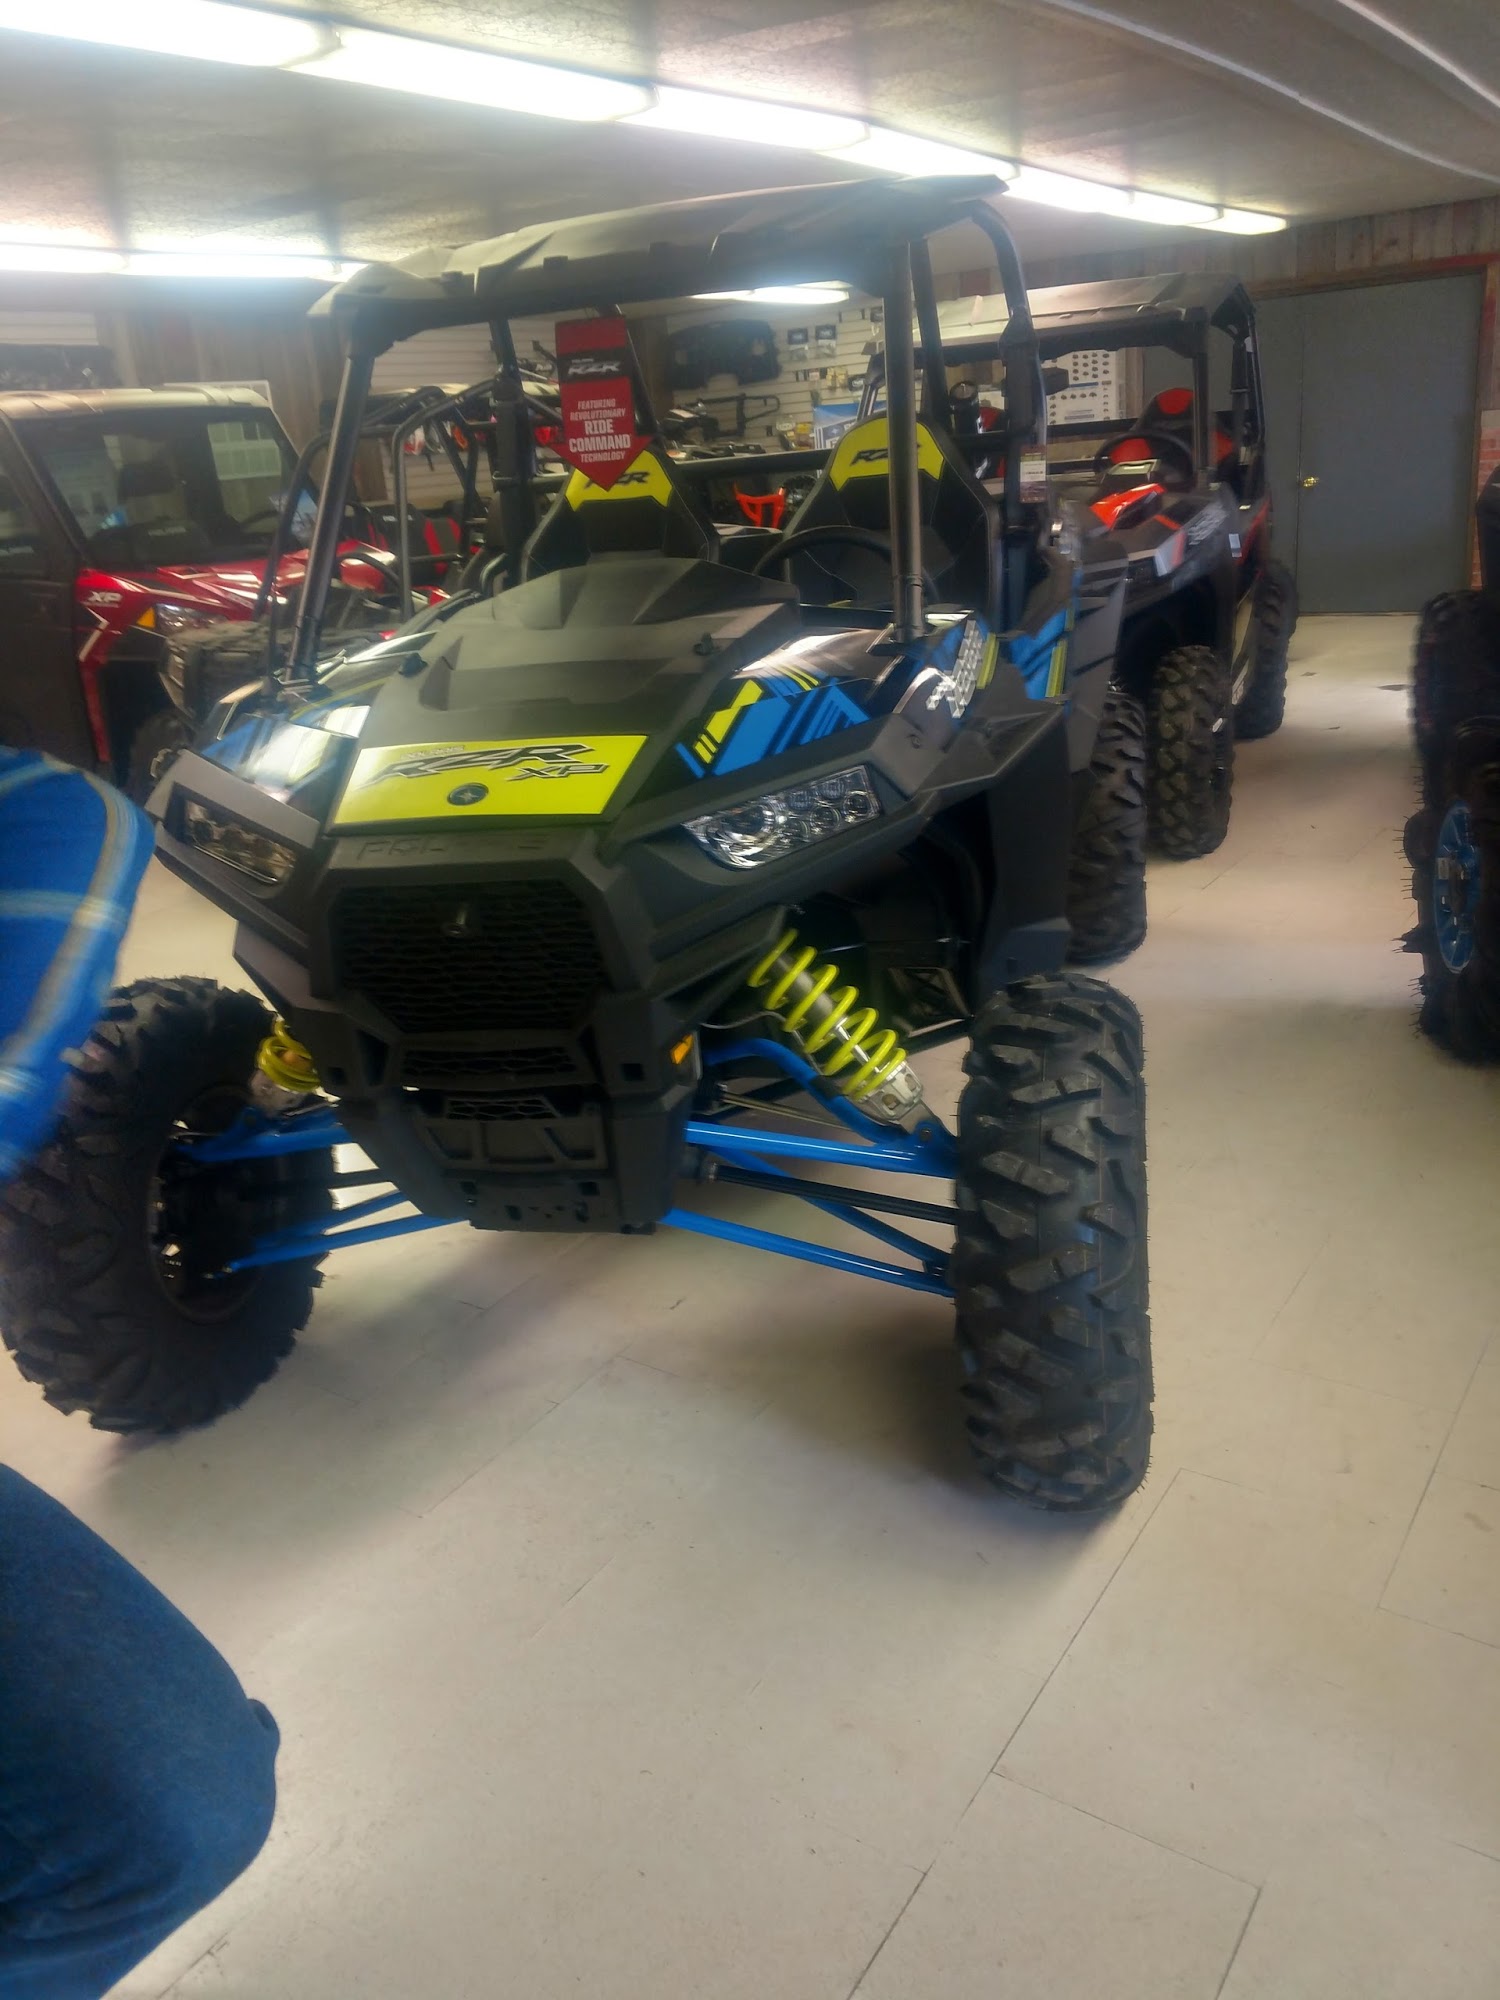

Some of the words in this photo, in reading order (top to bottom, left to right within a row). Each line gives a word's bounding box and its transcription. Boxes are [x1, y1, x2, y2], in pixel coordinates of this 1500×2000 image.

[577, 398, 616, 410] FEATURING
[570, 408, 626, 421] REVOLUTIONARY
[584, 419, 614, 435] RIDE
[569, 434, 631, 452] COMMAND
[580, 451, 626, 463] TECHNOLOGY
[87, 590, 123, 602] XP
[354, 743, 597, 790] RZR
[506, 763, 610, 782] XP
